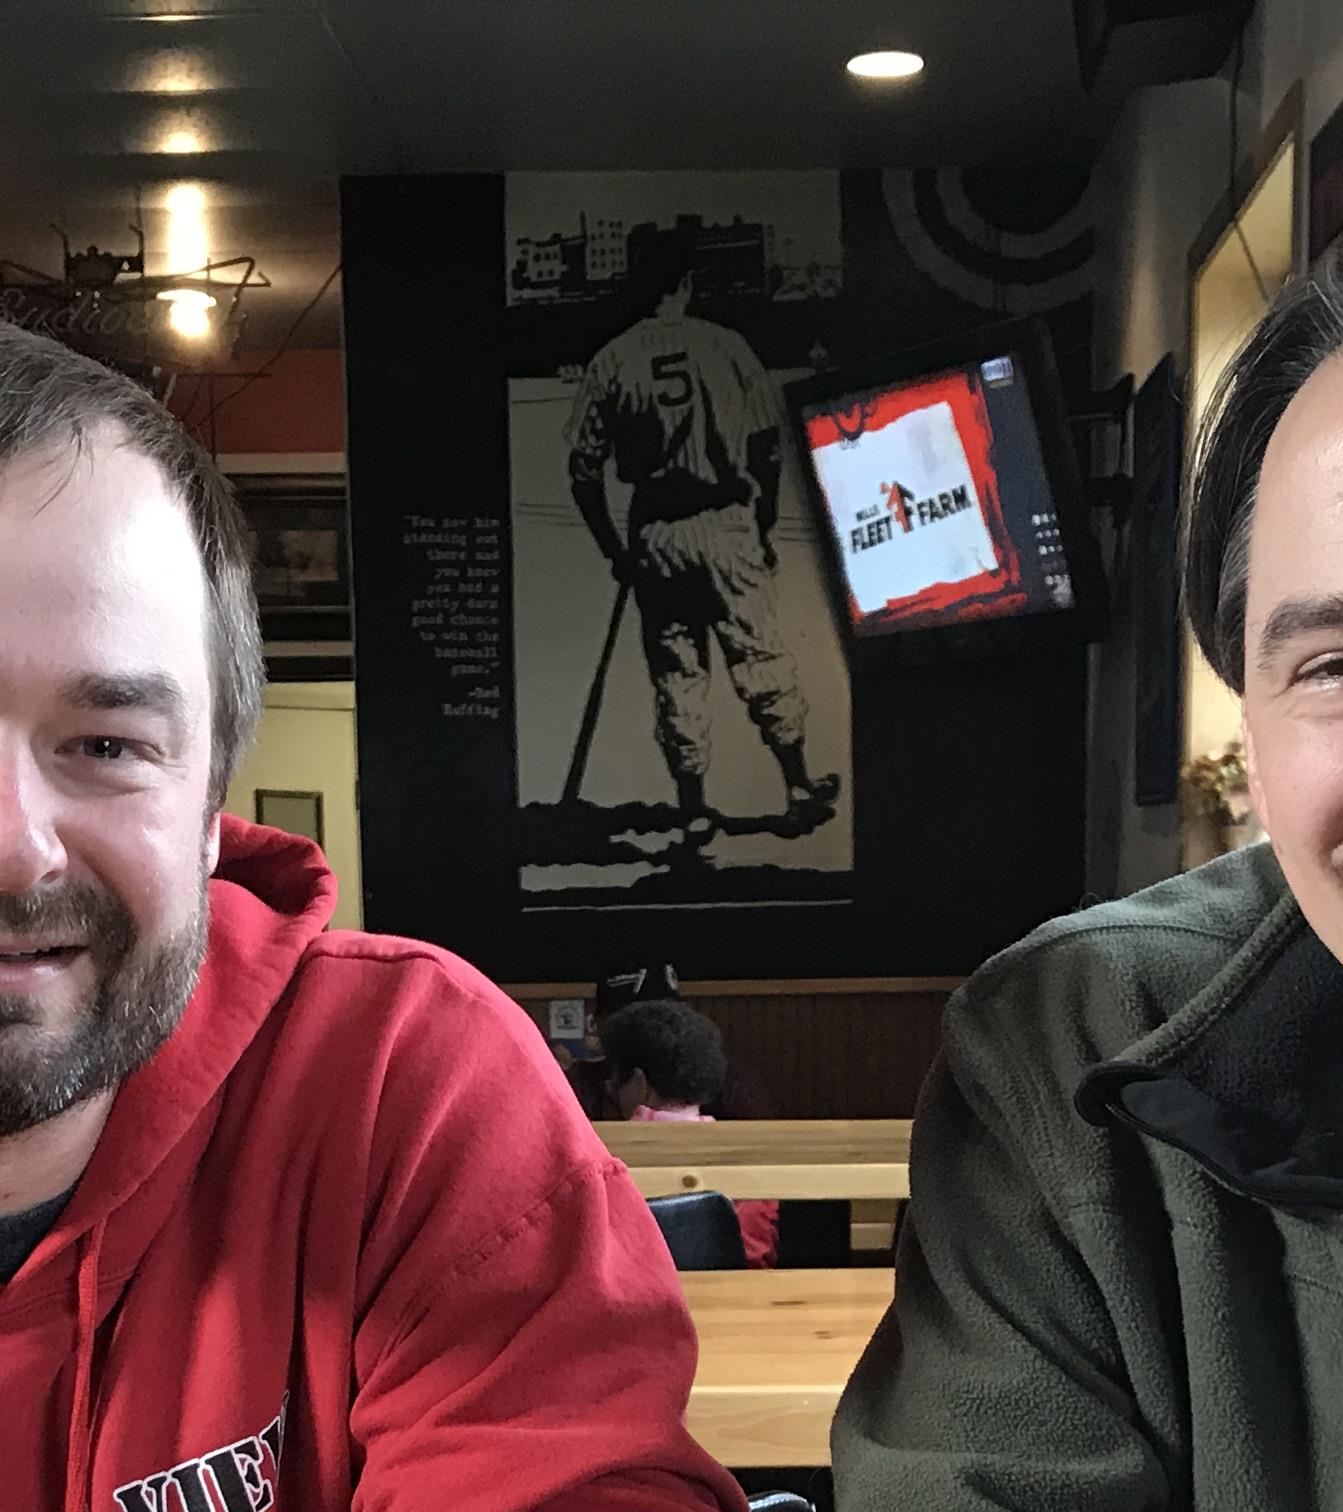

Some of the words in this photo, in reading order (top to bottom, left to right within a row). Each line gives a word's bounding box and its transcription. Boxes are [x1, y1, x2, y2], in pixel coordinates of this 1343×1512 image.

[650, 351, 693, 407] 5
[850, 514, 894, 553] FLEET
[916, 484, 972, 526] FARM
